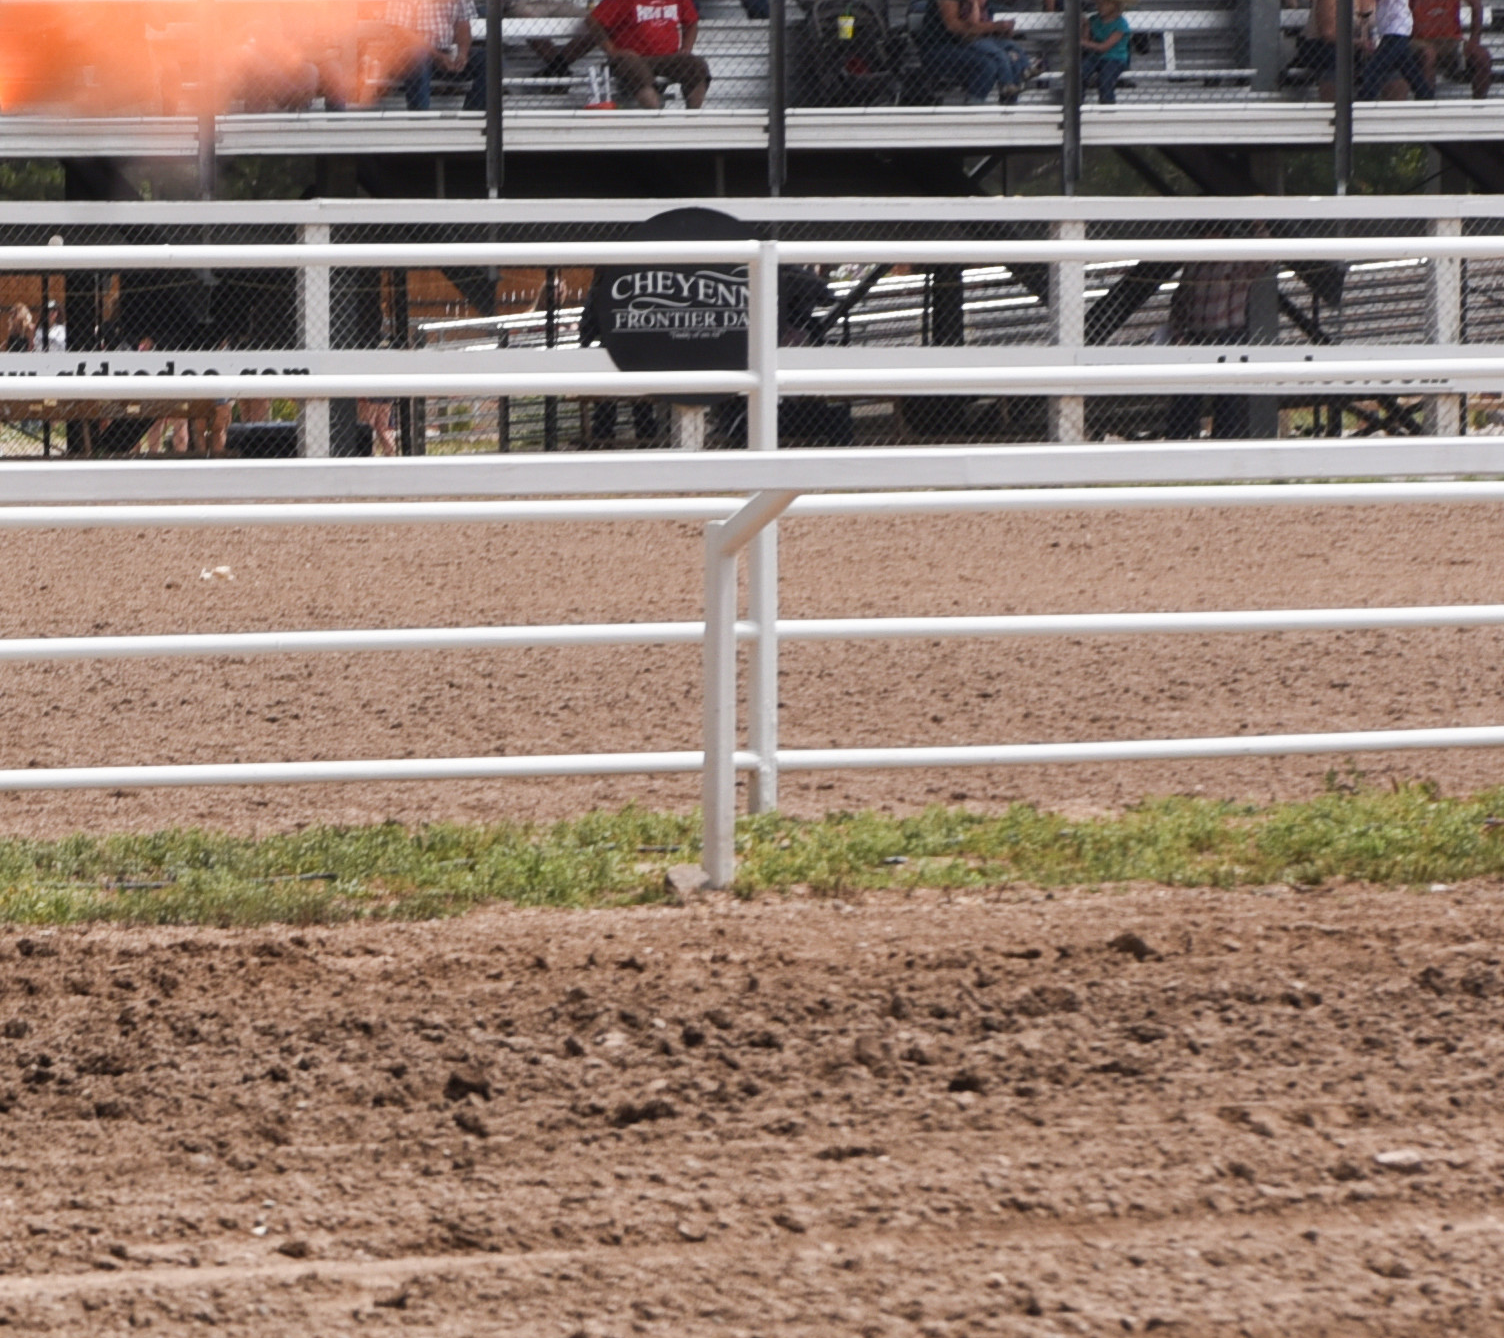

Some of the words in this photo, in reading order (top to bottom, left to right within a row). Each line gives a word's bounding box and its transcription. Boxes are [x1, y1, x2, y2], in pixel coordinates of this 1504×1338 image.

[610, 270, 750, 309] CHEYEN
[614, 312, 717, 329] FRONTIER
[723, 311, 750, 327] DA
